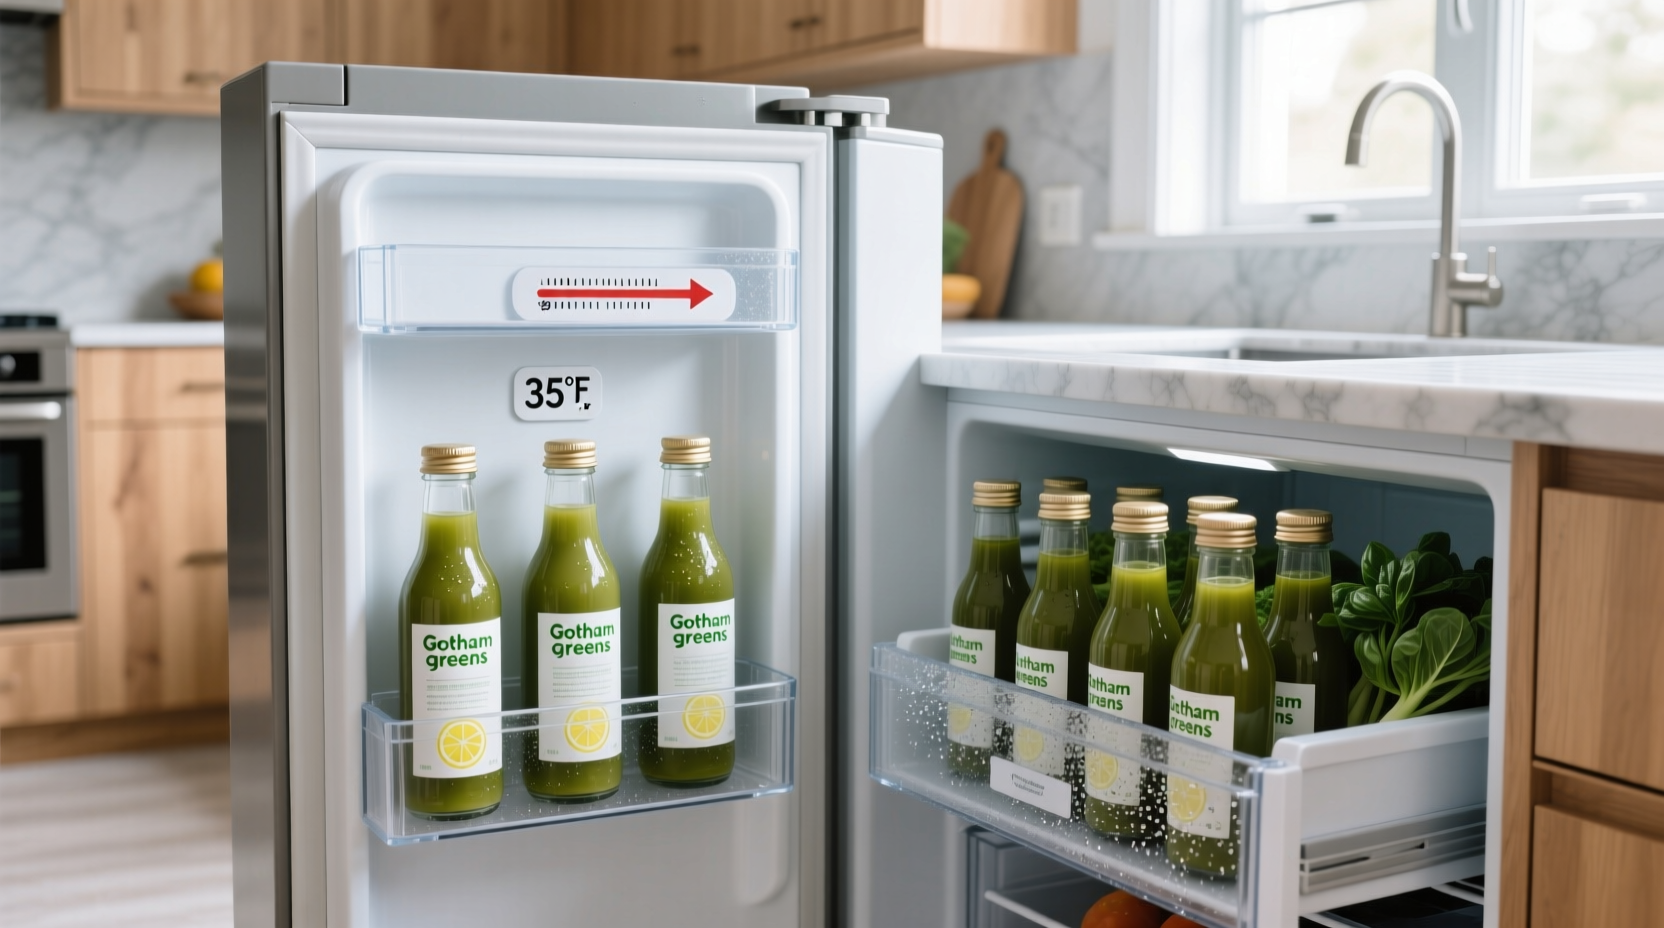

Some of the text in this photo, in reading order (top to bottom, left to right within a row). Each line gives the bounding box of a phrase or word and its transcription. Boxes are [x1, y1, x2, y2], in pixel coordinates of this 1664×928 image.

[525, 376, 590, 409] 35°F
[550, 622, 614, 640] Gotham
[670, 613, 731, 630] Gotham
[423, 633, 493, 652] Gotham
[673, 629, 727, 648] greens
[552, 640, 611, 659] greens
[426, 651, 487, 672] greens
